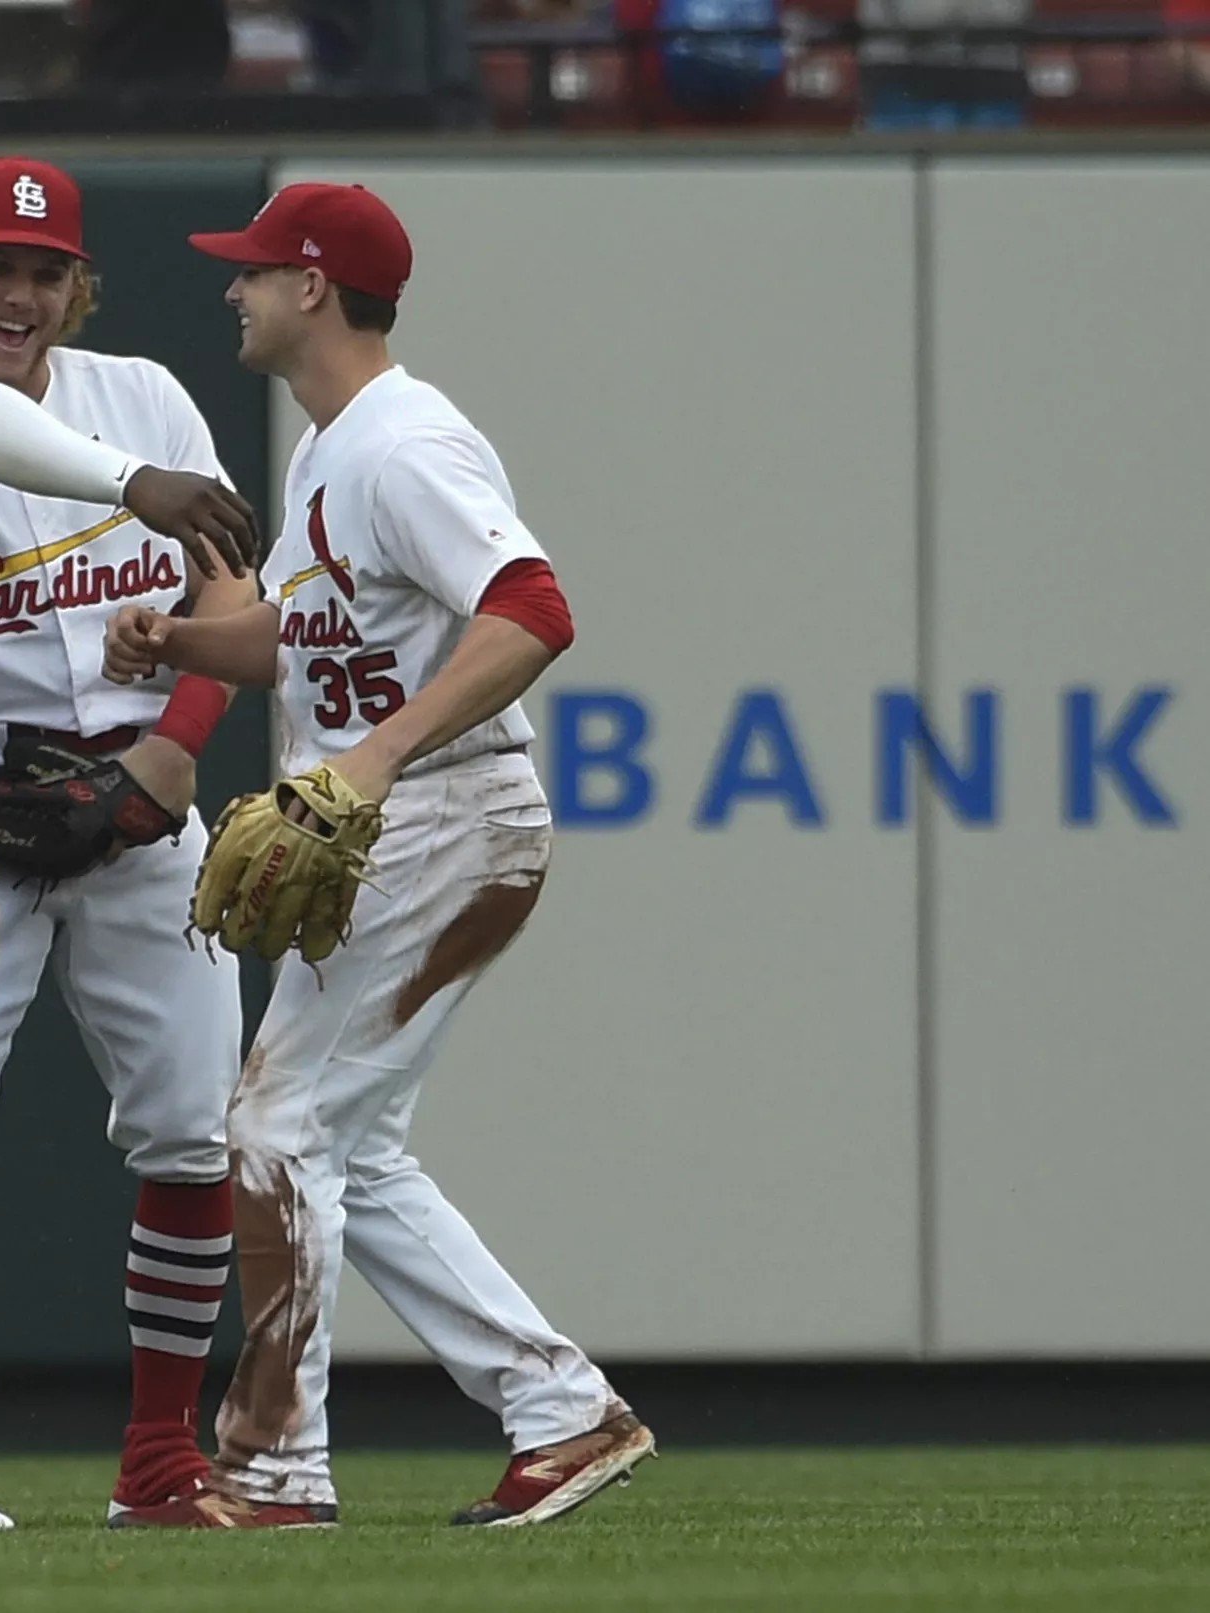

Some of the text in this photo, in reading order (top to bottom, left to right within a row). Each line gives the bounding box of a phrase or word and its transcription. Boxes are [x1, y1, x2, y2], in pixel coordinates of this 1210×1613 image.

[279, 597, 363, 648] nals
[307, 649, 407, 729] 35
[547, 688, 1178, 831] BANK
